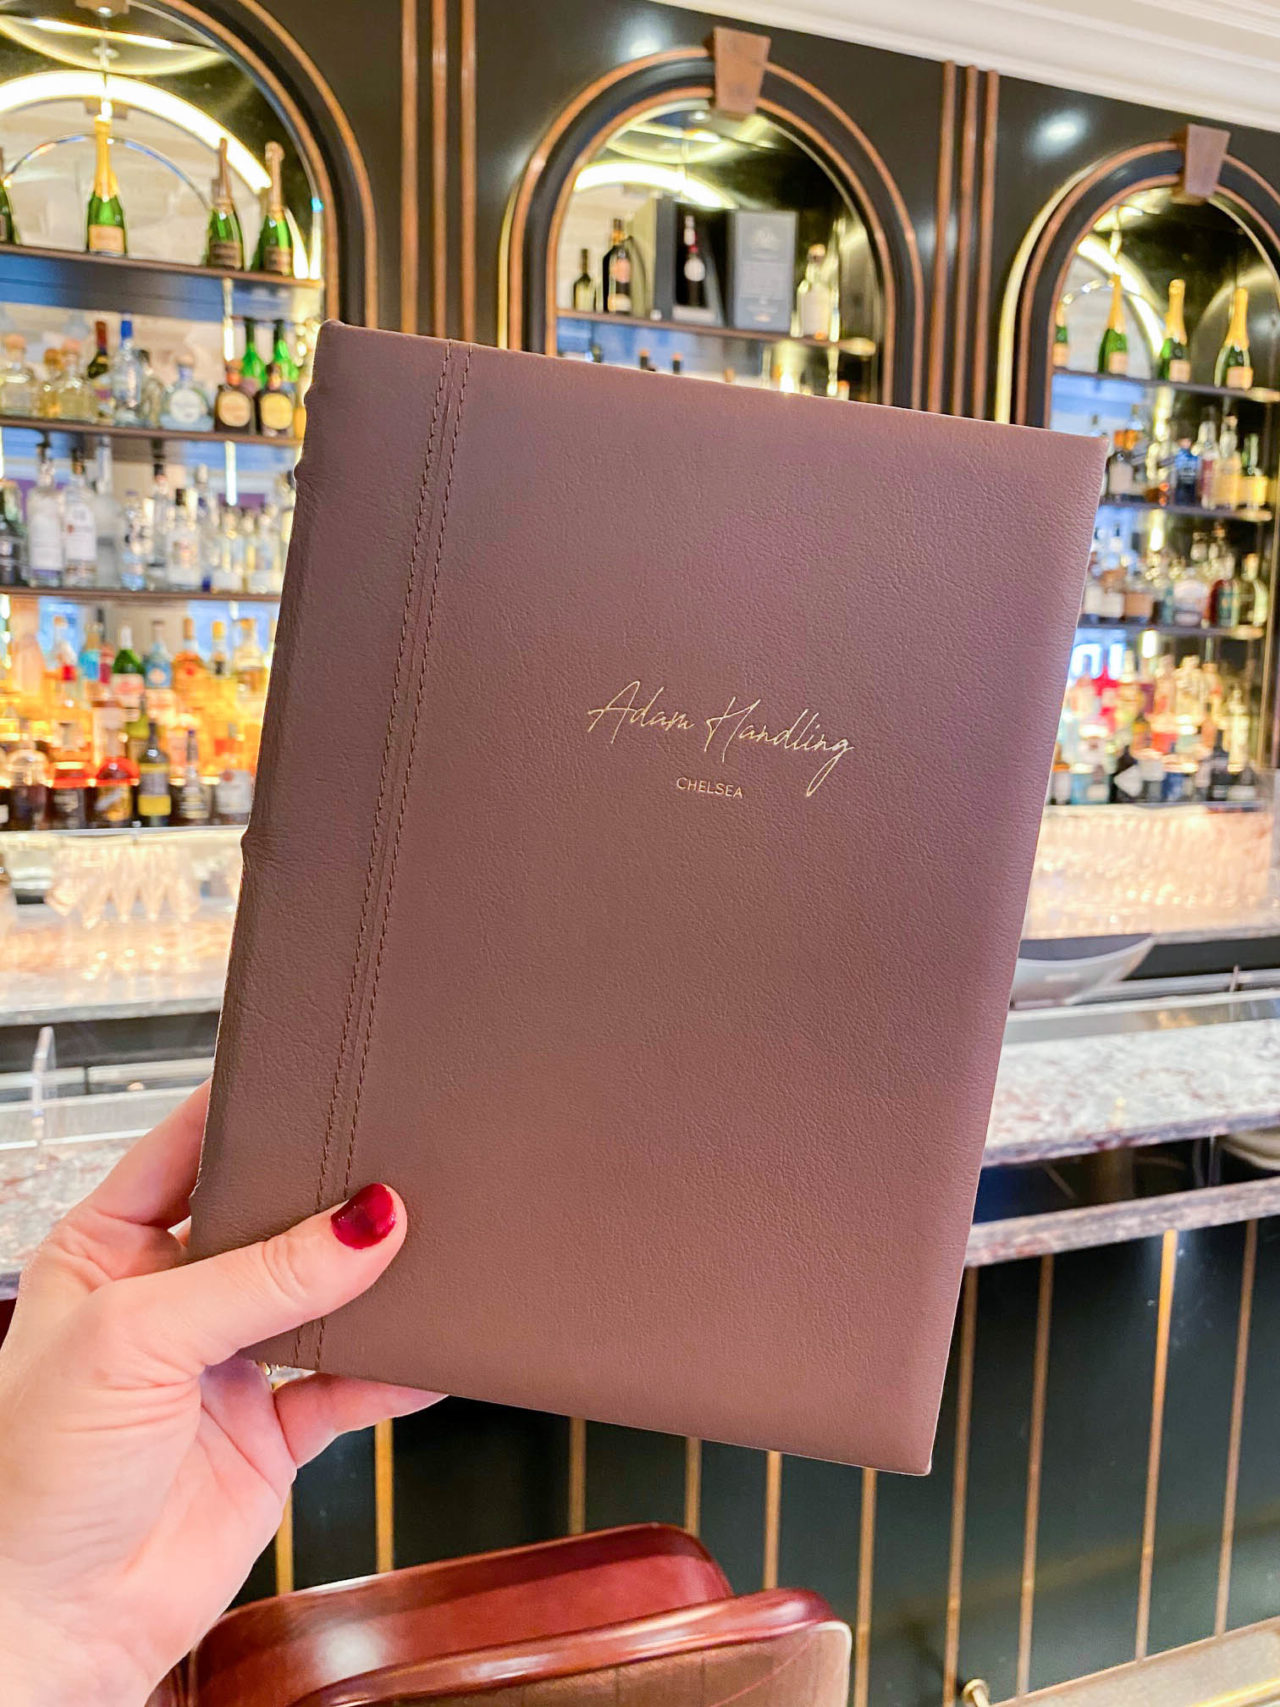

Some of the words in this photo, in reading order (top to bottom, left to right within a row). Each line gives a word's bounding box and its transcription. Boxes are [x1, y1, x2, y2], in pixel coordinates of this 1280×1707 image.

[587, 680, 695, 744] Adam
[705, 696, 854, 797] Handling
[676, 776, 743, 799] CHELSEA
